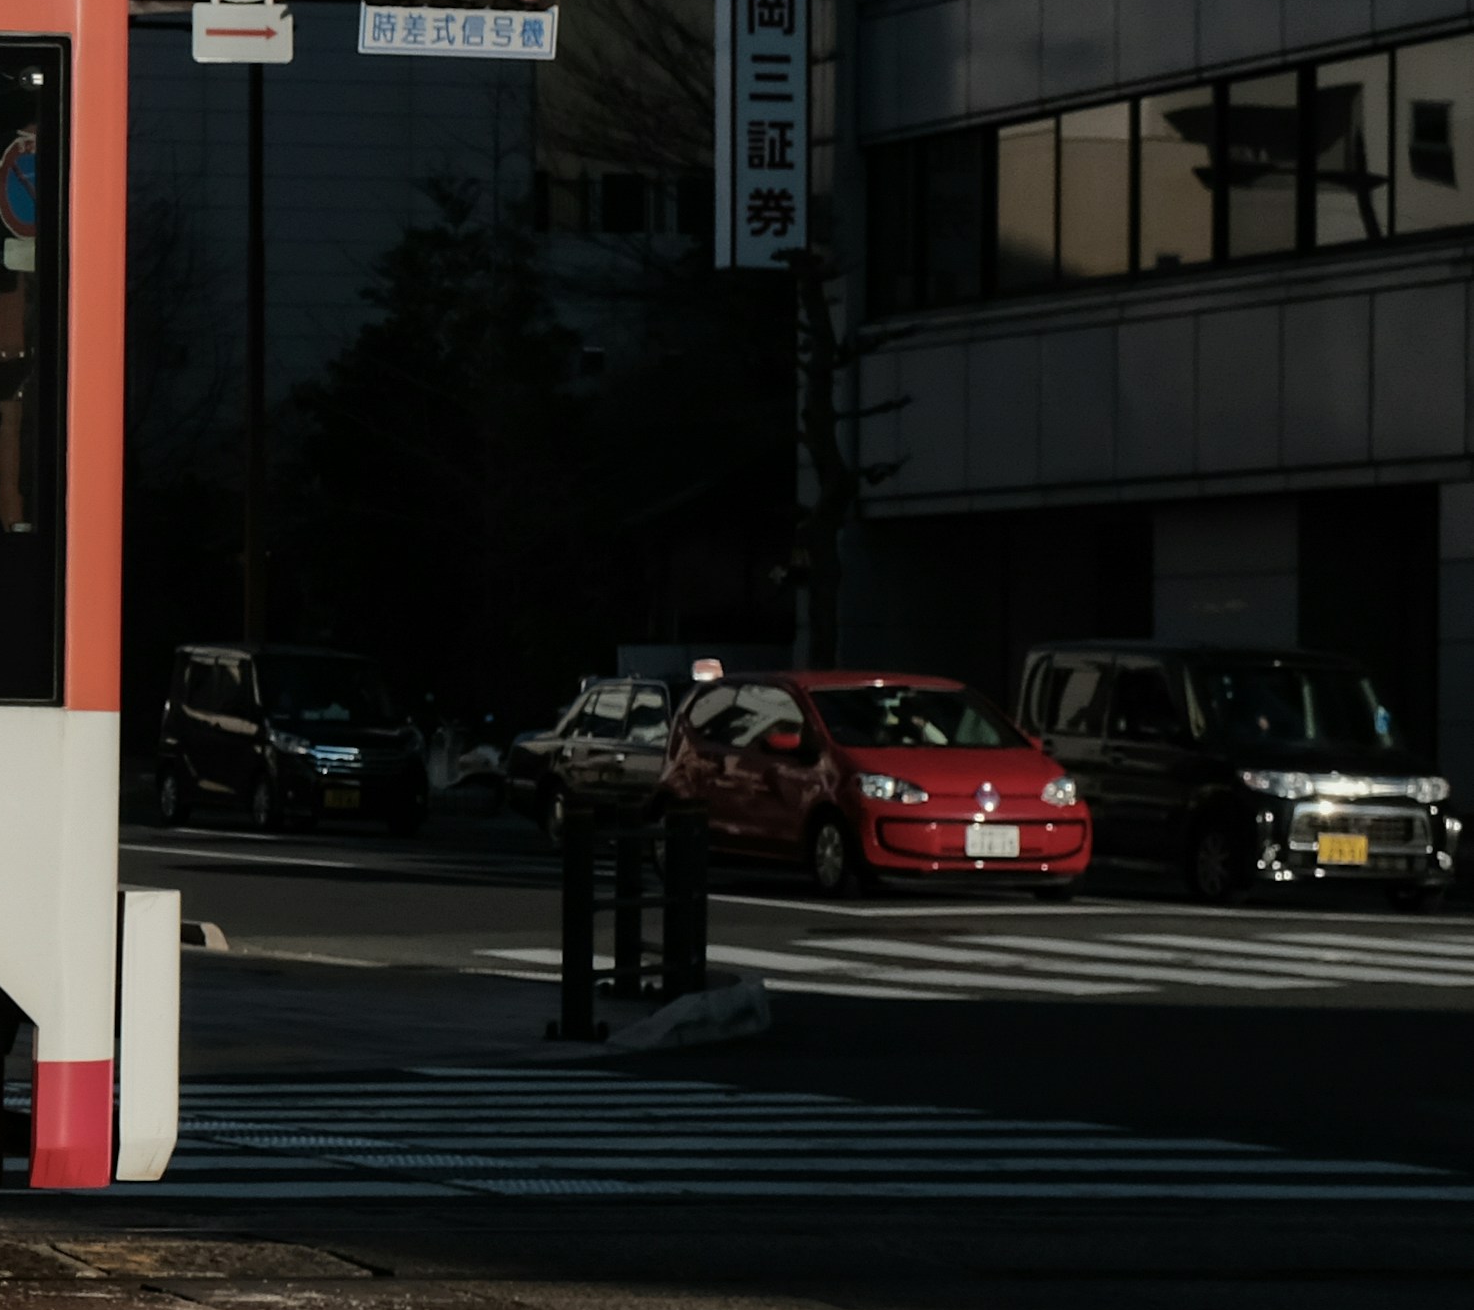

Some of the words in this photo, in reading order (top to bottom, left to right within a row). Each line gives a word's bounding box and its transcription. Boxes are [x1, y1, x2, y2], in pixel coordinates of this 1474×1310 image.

[372, 12, 546, 49] 時差式信号機
